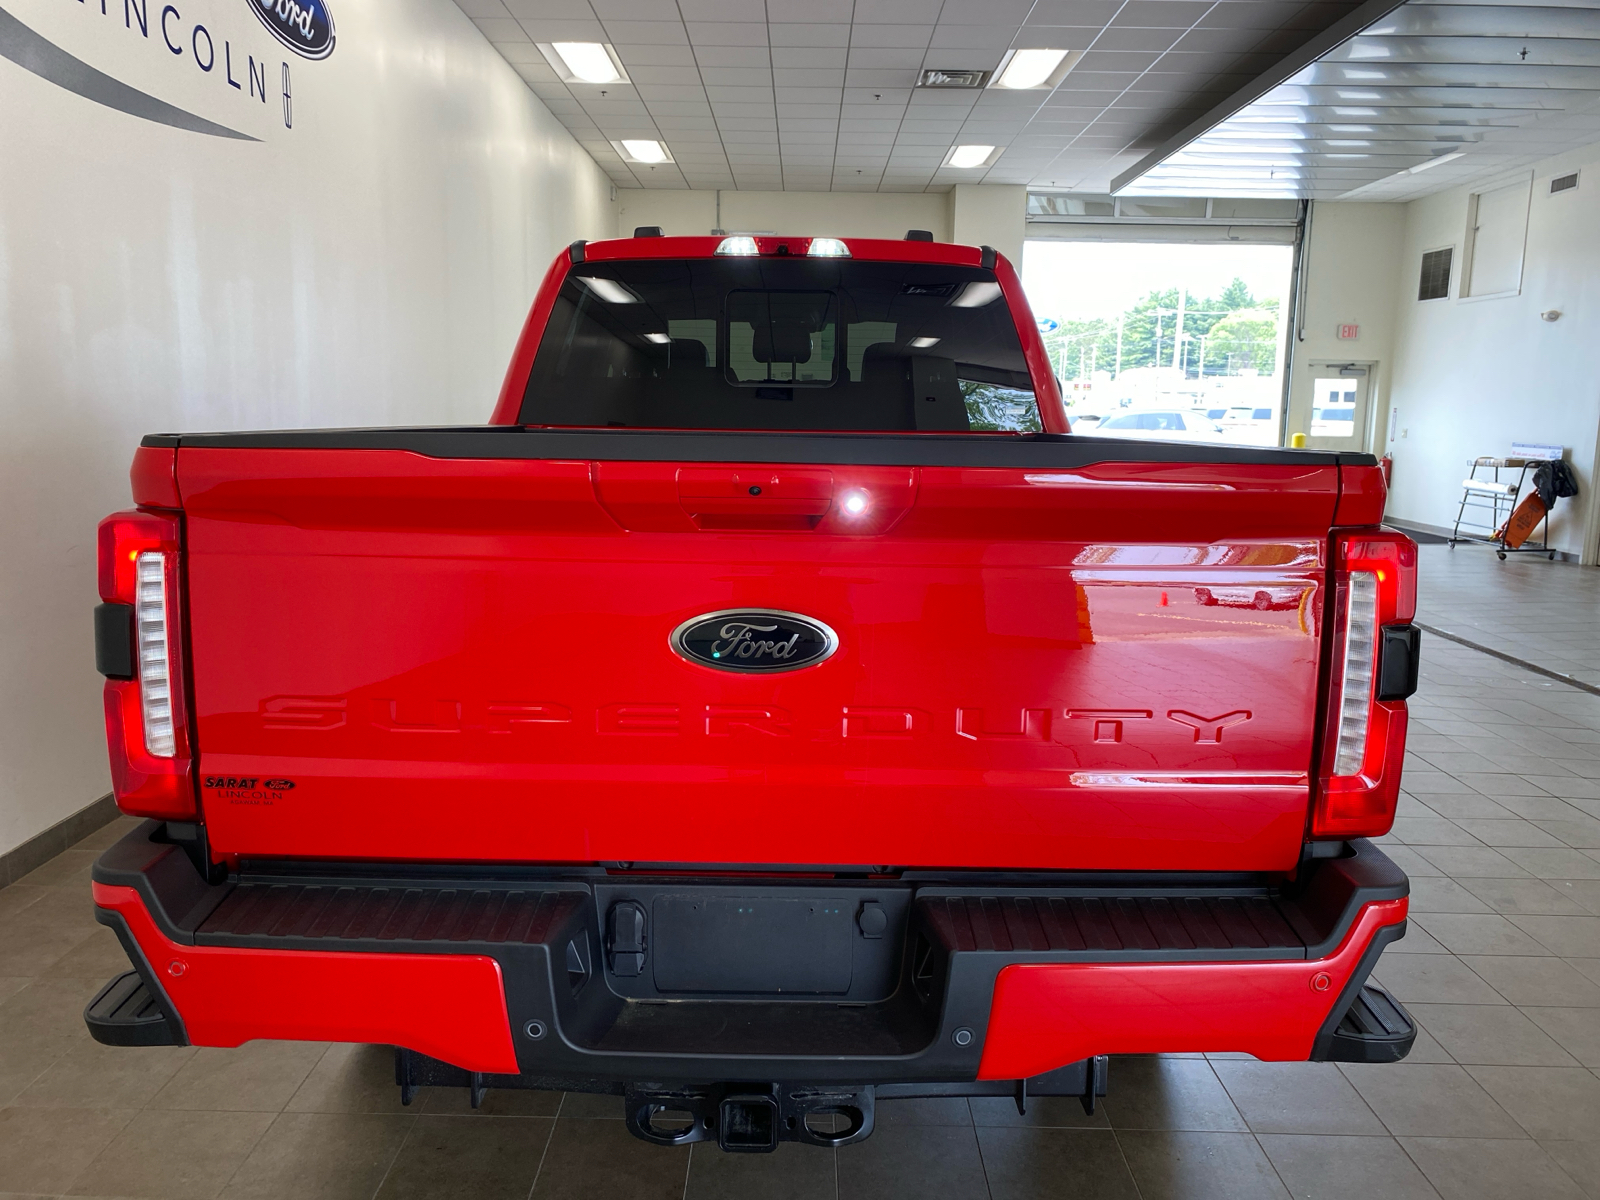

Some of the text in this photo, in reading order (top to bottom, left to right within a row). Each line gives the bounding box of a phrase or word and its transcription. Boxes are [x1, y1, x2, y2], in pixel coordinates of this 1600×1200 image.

[262, 0, 315, 40] ord
[78, 0, 266, 103] NCOLN
[1342, 325, 1359, 338] EXIT
[711, 622, 799, 659] Ford
[260, 694, 1253, 744] SUPER DUTY
[204, 776, 259, 790] SARAT
[217, 790, 283, 800] LINCOLN
